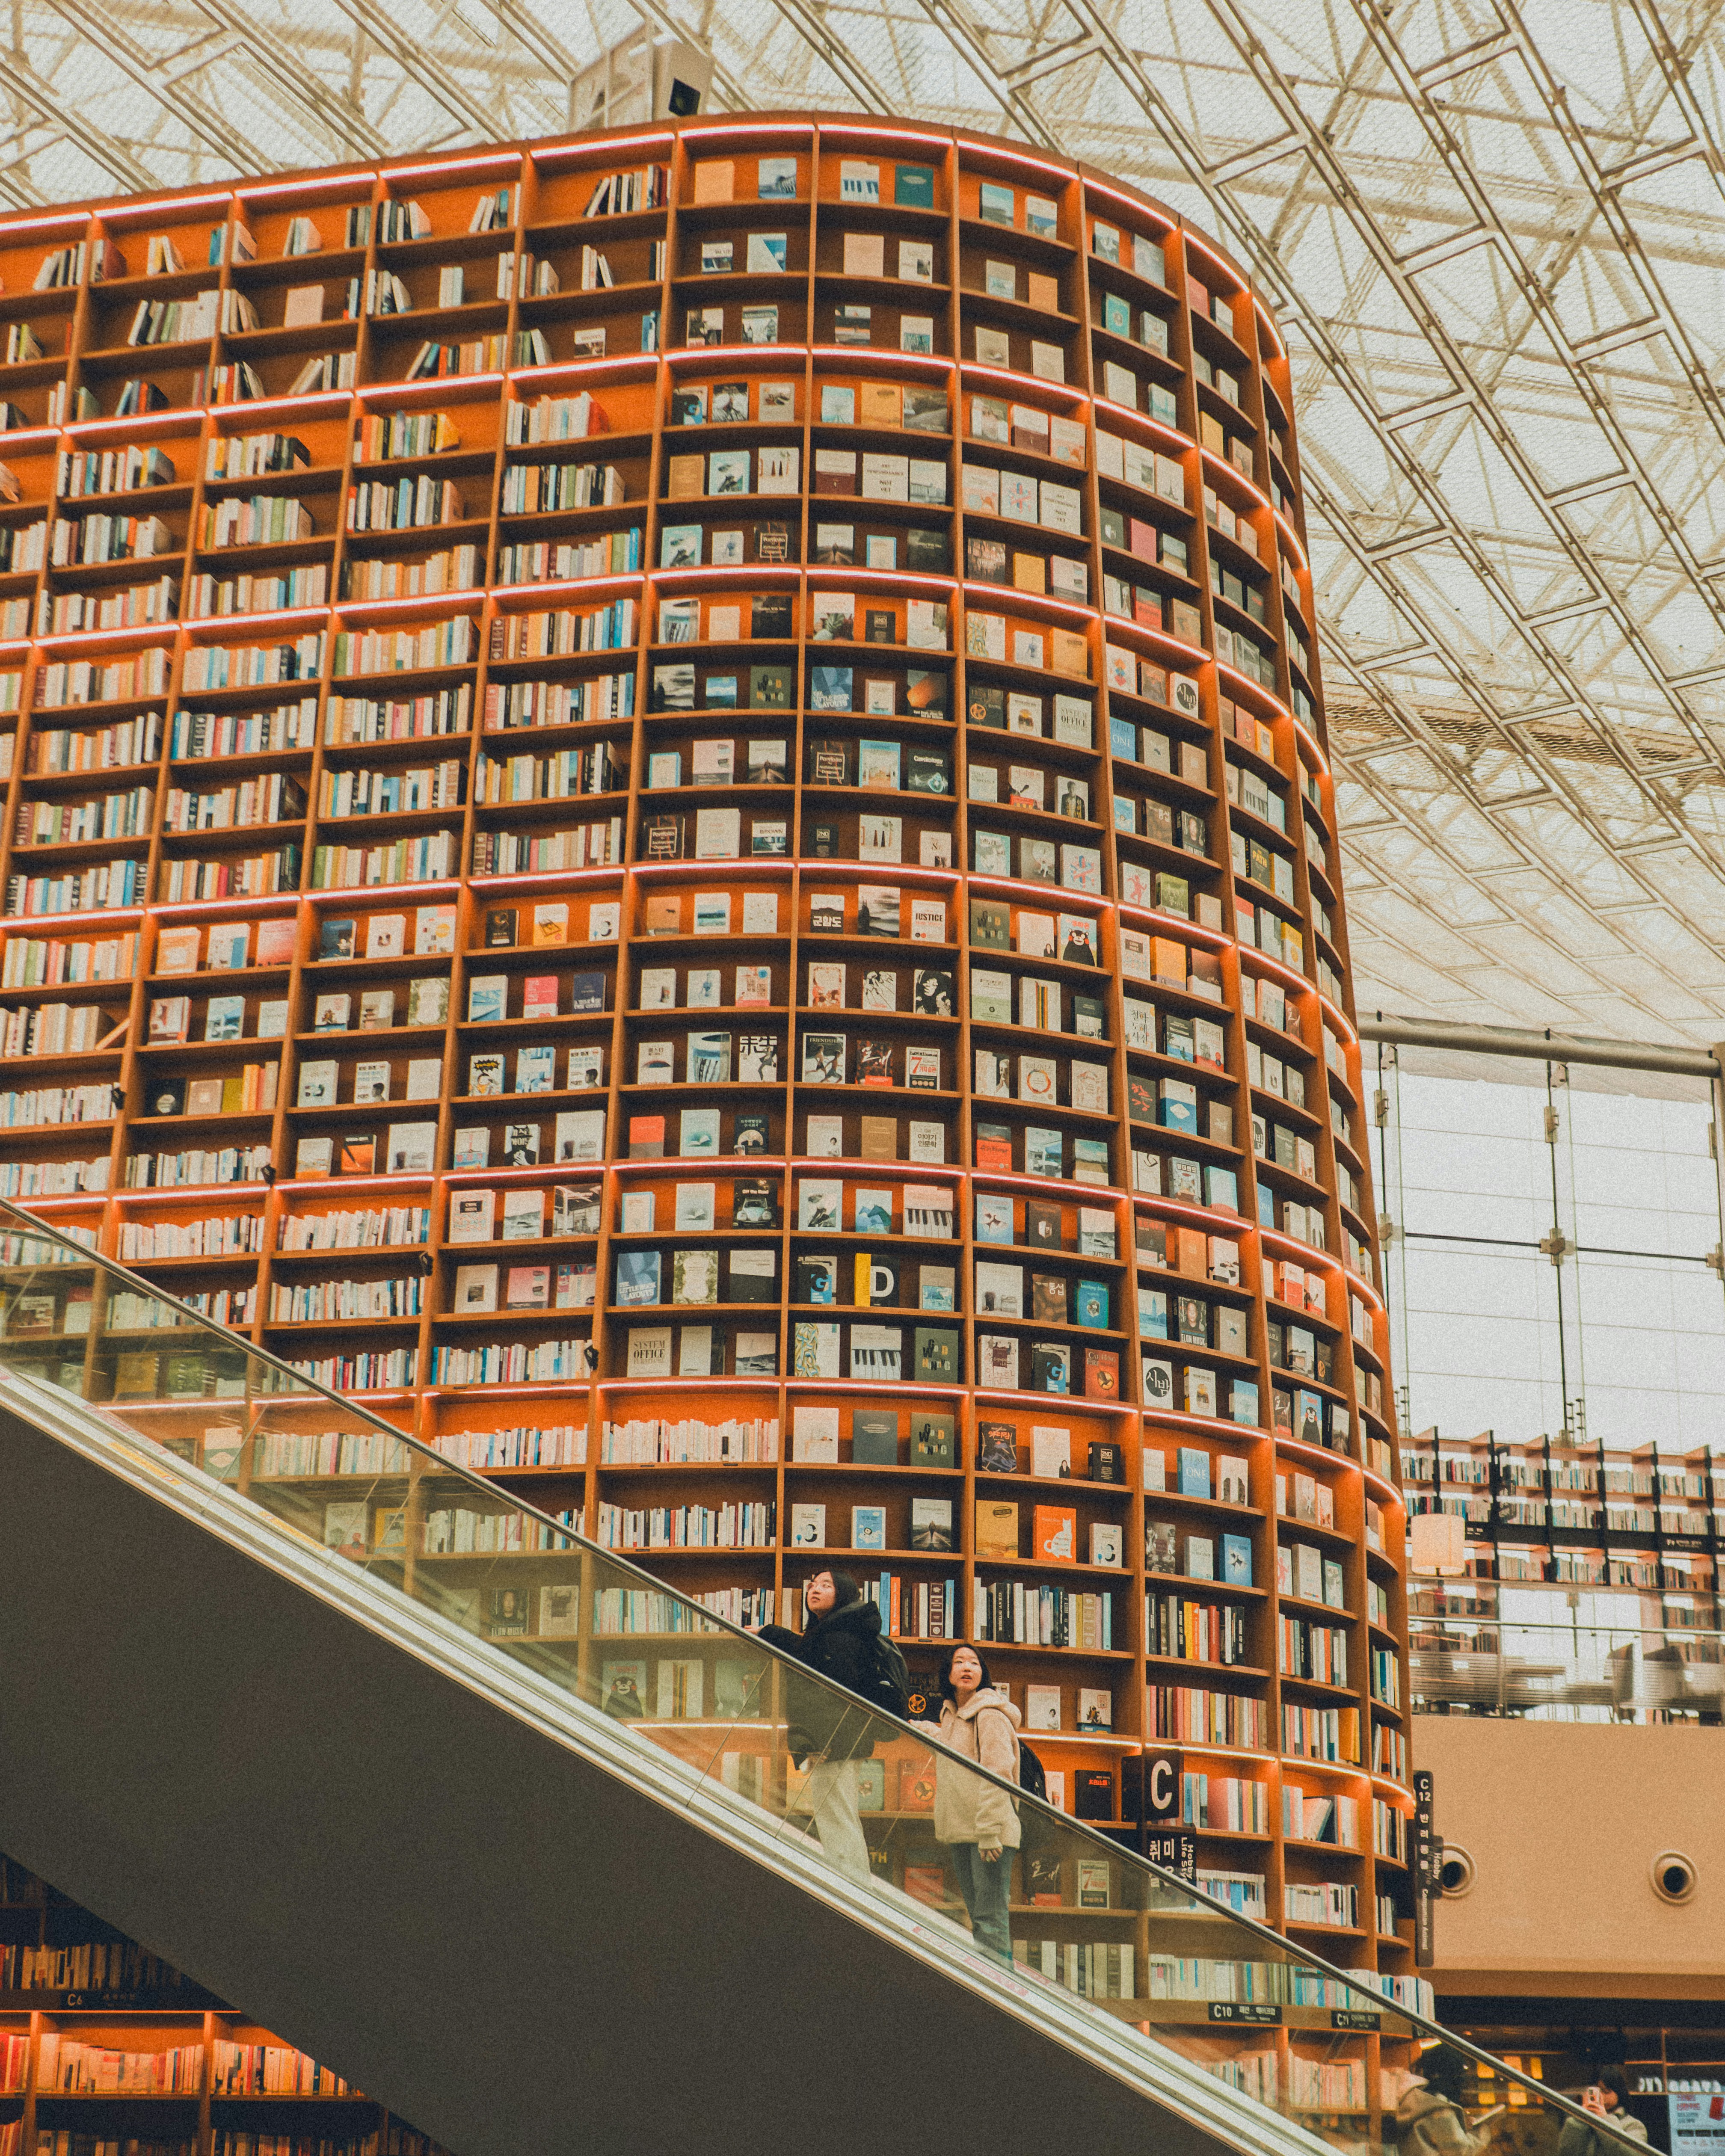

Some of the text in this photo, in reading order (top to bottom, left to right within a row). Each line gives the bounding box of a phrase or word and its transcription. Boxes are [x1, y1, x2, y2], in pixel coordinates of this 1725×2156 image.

[1061, 715, 1085, 727] OFFICE
[1252, 850, 1267, 868] PATH
[813, 915, 842, 927] 군함도
[916, 912, 943, 922] JUSTICE
[911, 1056, 923, 1074] 7
[870, 1266, 895, 1297] D
[1049, 1282, 1064, 1297] 통섭
[634, 1340, 665, 1349] SYSTEM
[1181, 1333, 1206, 1346] ELON MUSK
[634, 1349, 663, 1359] OFFICE
[1146, 1369, 1170, 1396] 시밤
[1186, 1466, 1206, 1481] ONE
[491, 1627, 524, 1636] ELON MUSK
[1151, 1759, 1172, 1810] C
[1420, 1779, 1429, 1790] C
[1419, 1792, 1431, 1801] 12
[870, 1851, 887, 1864] TH
[1432, 1852, 1442, 1881] Hobby
[1082, 1870, 1093, 1889] 7
[67, 1993, 83, 2007] C6
[1214, 2004, 1233, 2018] C10
